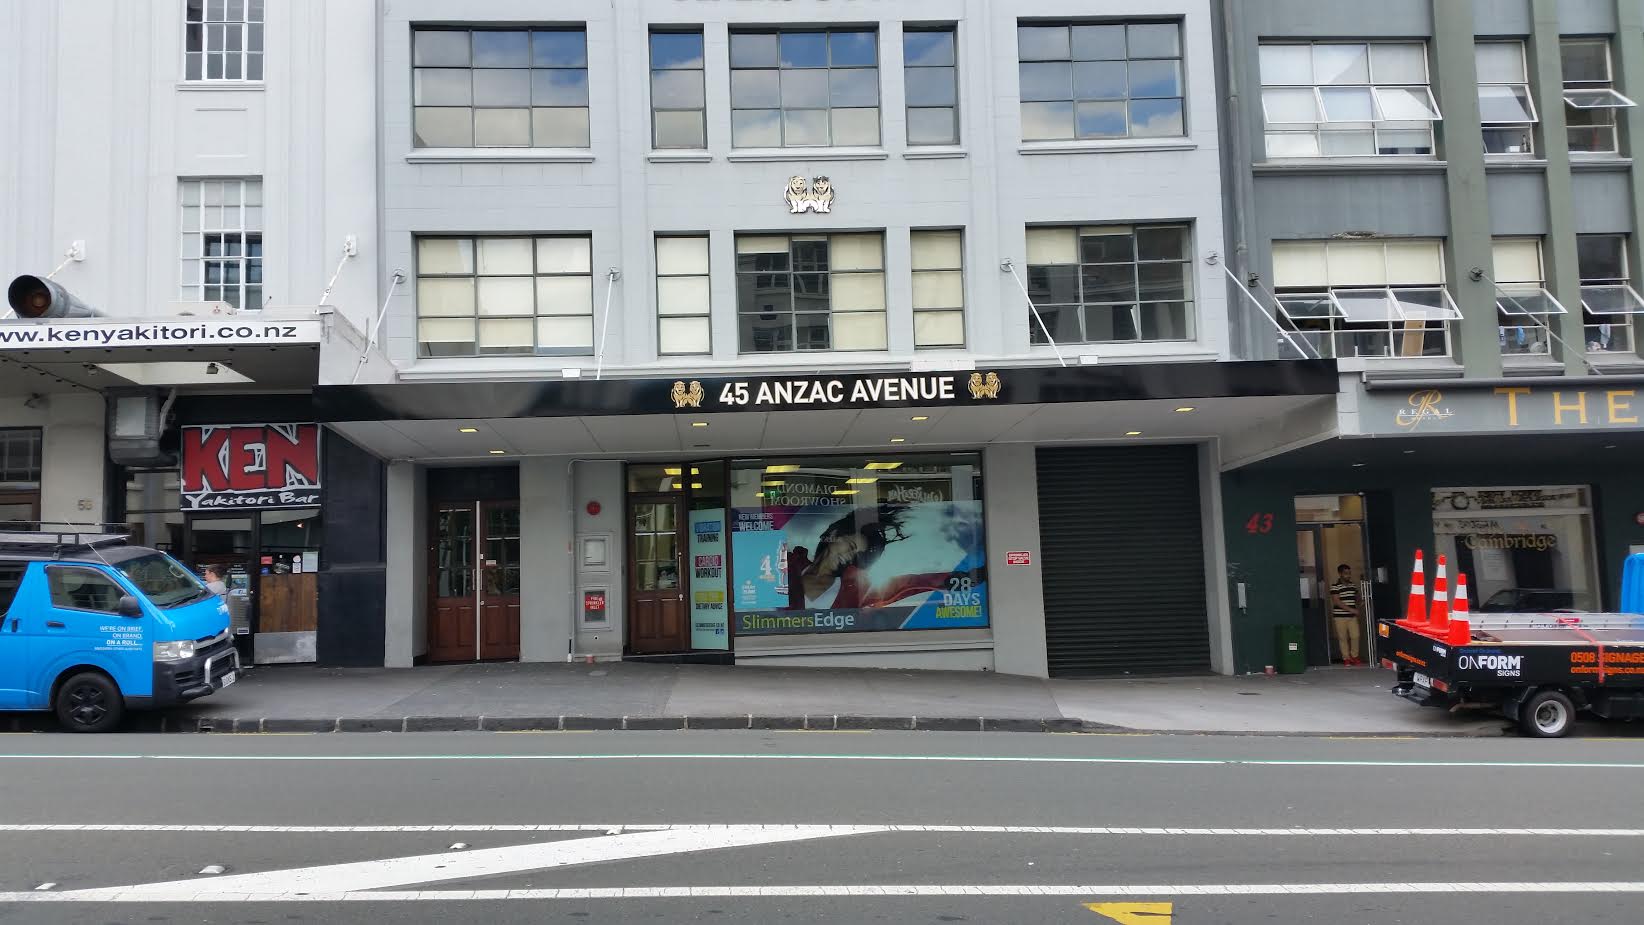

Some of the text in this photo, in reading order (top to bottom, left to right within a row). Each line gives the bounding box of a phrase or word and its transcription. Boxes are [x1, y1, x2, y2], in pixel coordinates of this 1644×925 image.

[719, 376, 955, 405] 45 ANZAC AVENUE
[1493, 386, 1639, 426] THE
[182, 425, 318, 492] KEN
[185, 491, 319, 509] Yakitori Bar
[738, 520, 774, 531] WELCOME
[1246, 512, 1274, 534] 43
[1464, 533, 1557, 551] Cambridge
[760, 554, 772, 576] 4
[949, 576, 972, 592] 28
[943, 592, 981, 606] DAYS
[936, 605, 982, 618] AWESOME!
[742, 612, 855, 630] SlimmersEdge
[1458, 655, 1521, 670] ONFORM
[1598, 652, 1644, 663] IGNAGE
